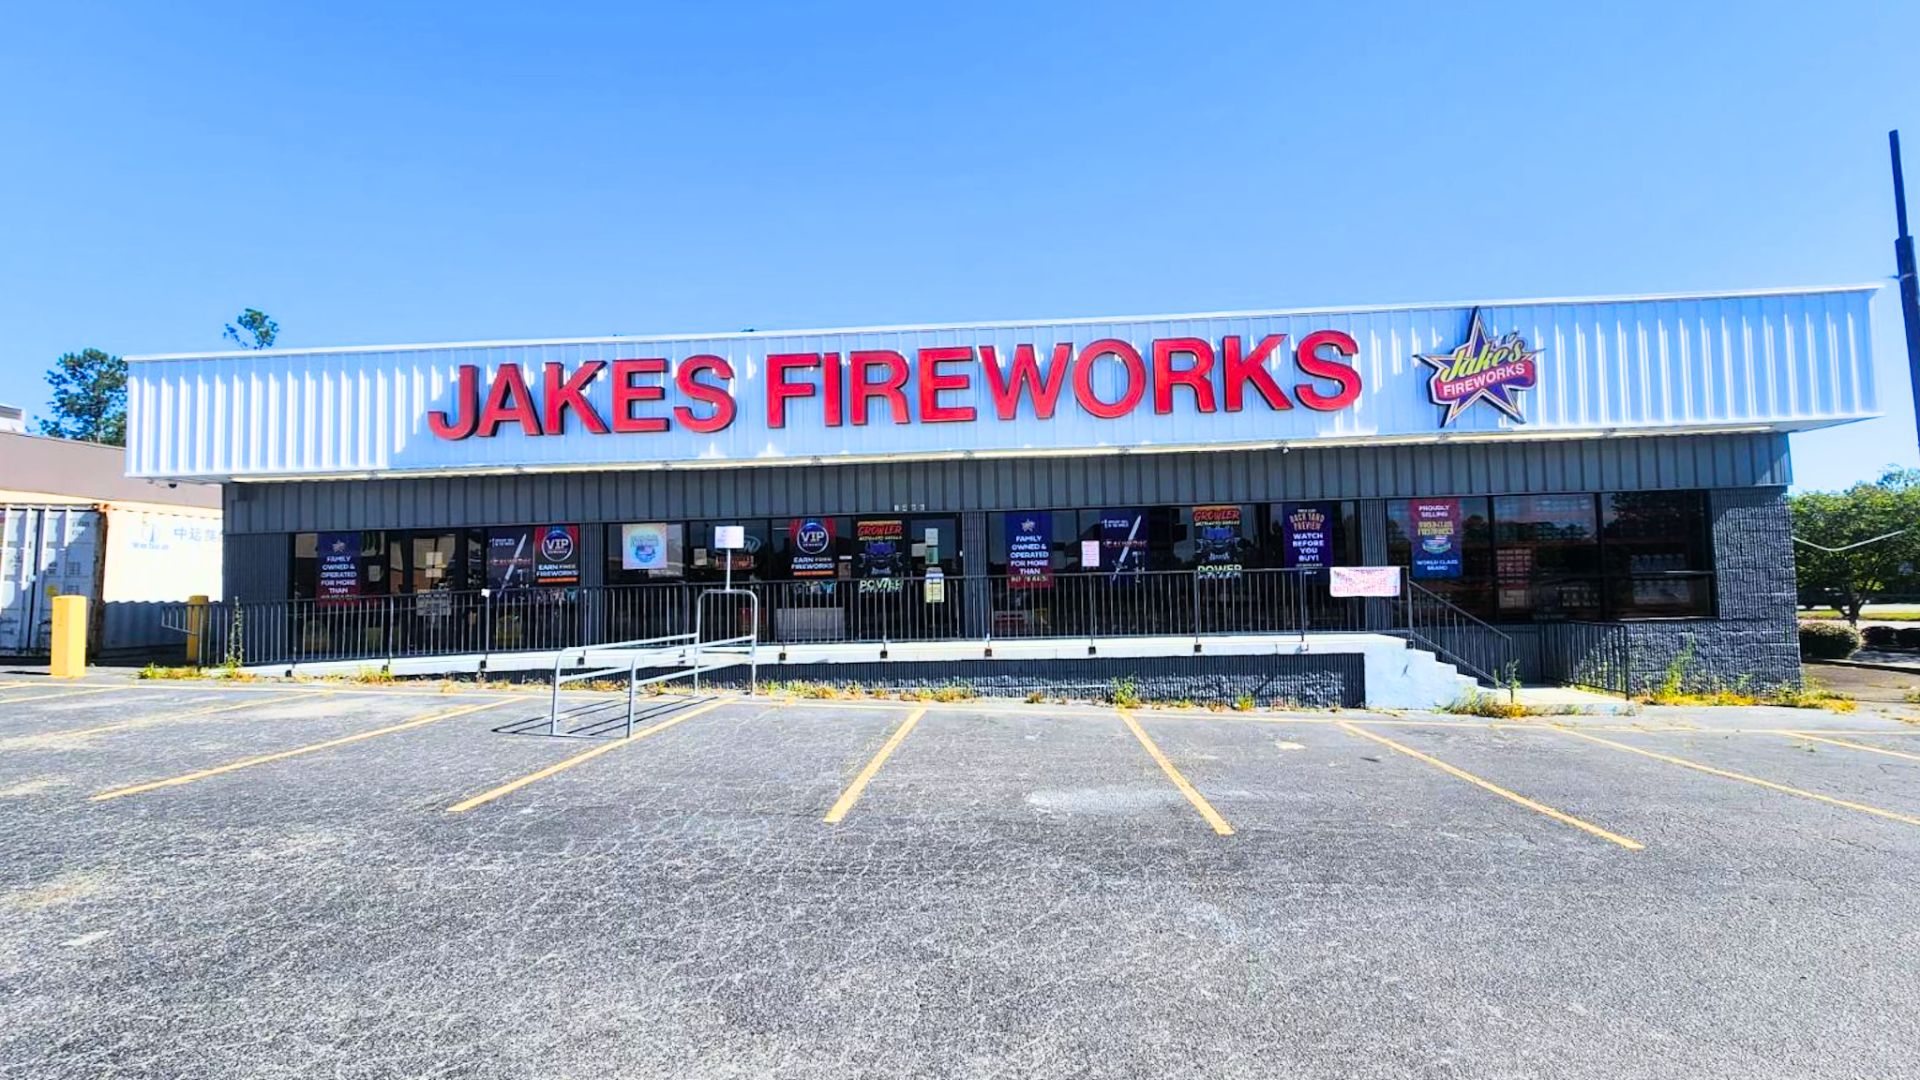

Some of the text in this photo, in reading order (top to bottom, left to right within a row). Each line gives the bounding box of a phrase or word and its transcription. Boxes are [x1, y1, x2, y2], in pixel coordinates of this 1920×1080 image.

[1443, 363, 1526, 396] FIREWORKS
[428, 330, 1363, 441] JAKES FIREWORKS
[1194, 510, 1240, 521] GROWLER
[858, 525, 902, 536] GROWLER
[801, 531, 825, 542] VIP
[1015, 535, 1042, 543] FAMILY
[1292, 532, 1324, 540] WATCH
[546, 539, 569, 550] VIP
[1011, 543, 1041, 551] OWNED
[1010, 550, 1049, 559] OPERATED
[321, 563, 349, 571] OWNED
[1010, 559, 1048, 567] FOR MORE
[320, 571, 357, 579] OPERATED
[1019, 567, 1041, 575] THAN
[320, 579, 356, 587] FOR MORE
